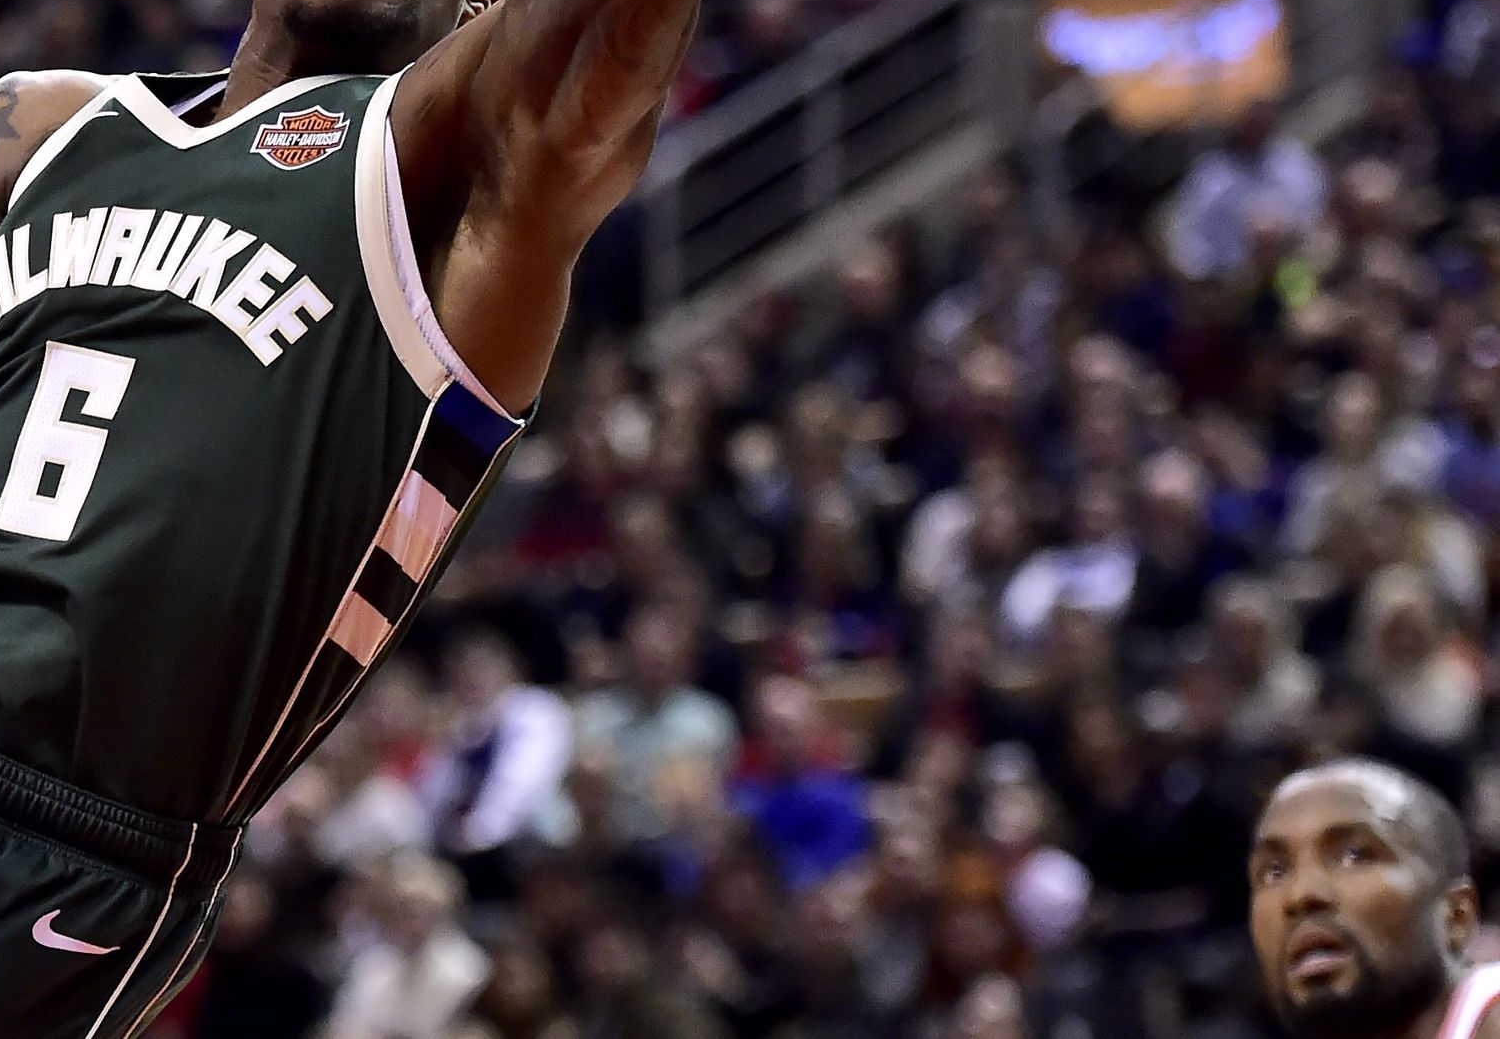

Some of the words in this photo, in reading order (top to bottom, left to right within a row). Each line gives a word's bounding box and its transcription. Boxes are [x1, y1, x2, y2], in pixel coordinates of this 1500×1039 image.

[290, 117, 331, 129] MOTOR
[264, 131, 340, 146] HARLEY-DAVIDSON
[276, 148, 318, 163] CYCLES
